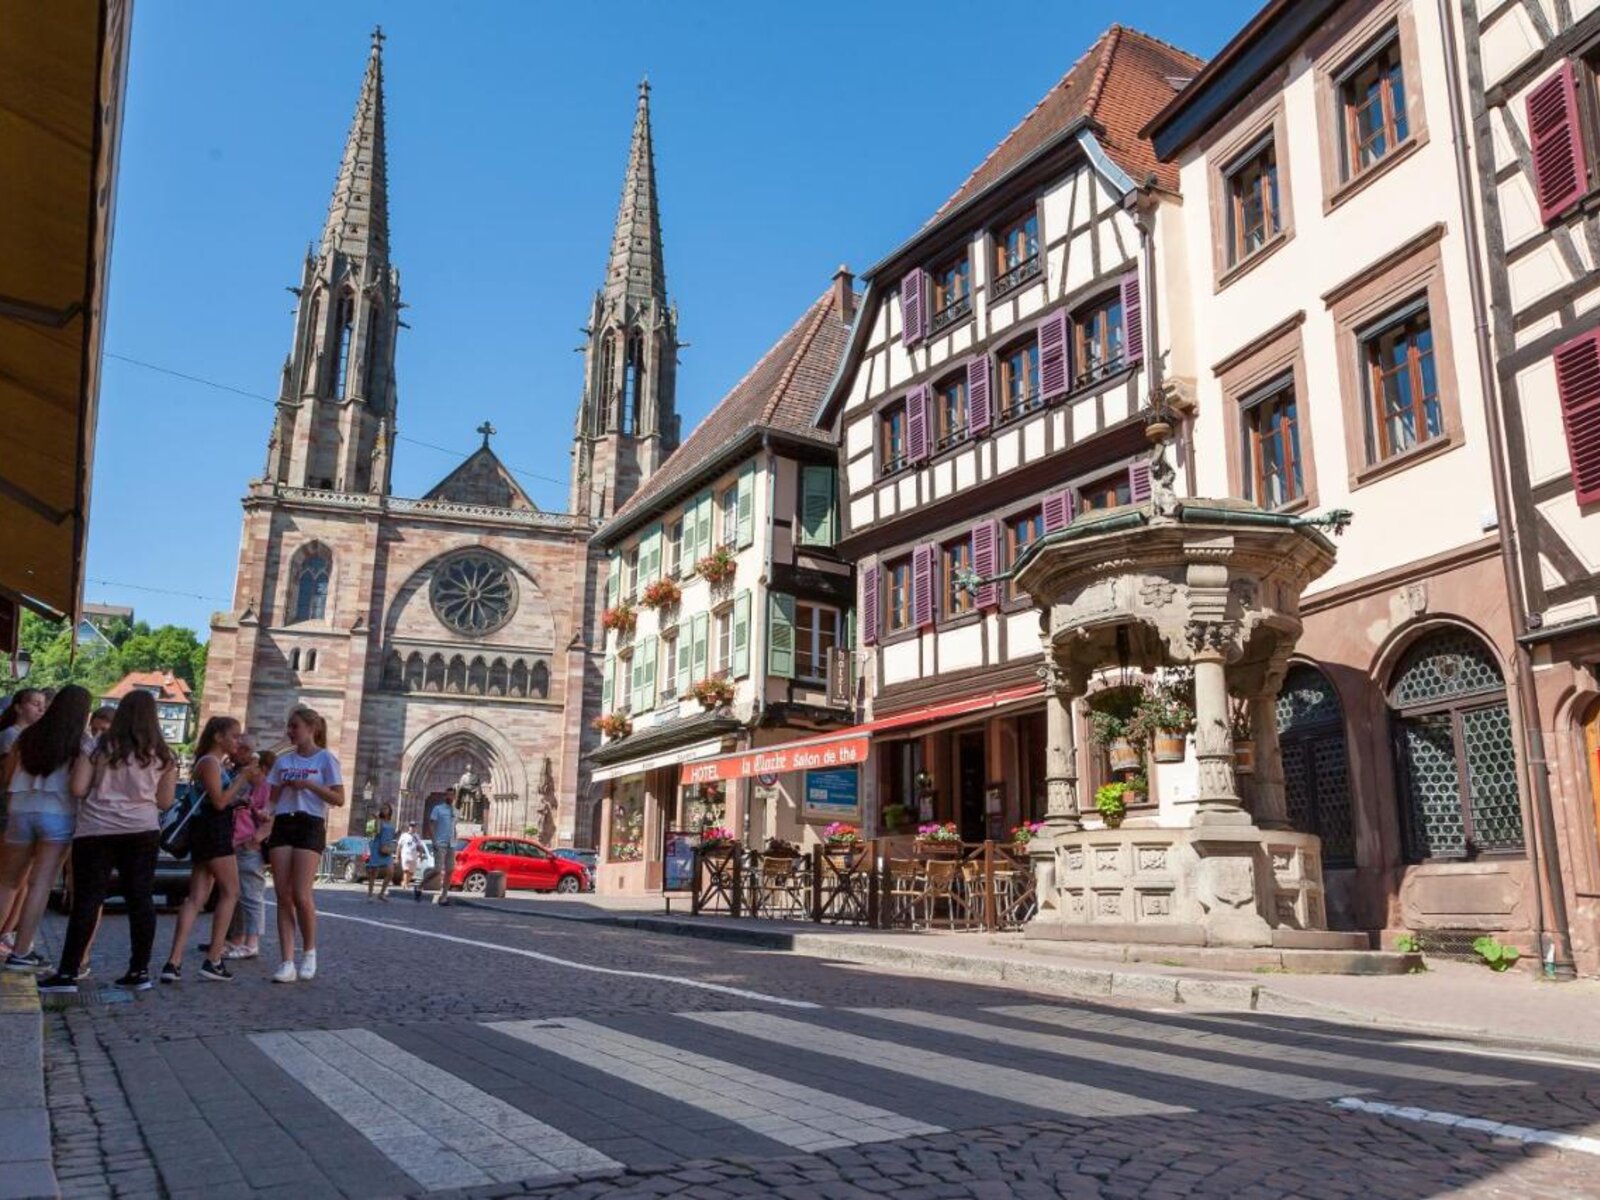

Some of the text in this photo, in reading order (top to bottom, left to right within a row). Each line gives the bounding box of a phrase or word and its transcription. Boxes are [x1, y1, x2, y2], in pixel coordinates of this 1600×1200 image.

[691, 765, 719, 781] HOTEL
[824, 750, 835, 764] de
[840, 747, 856, 762] thé
